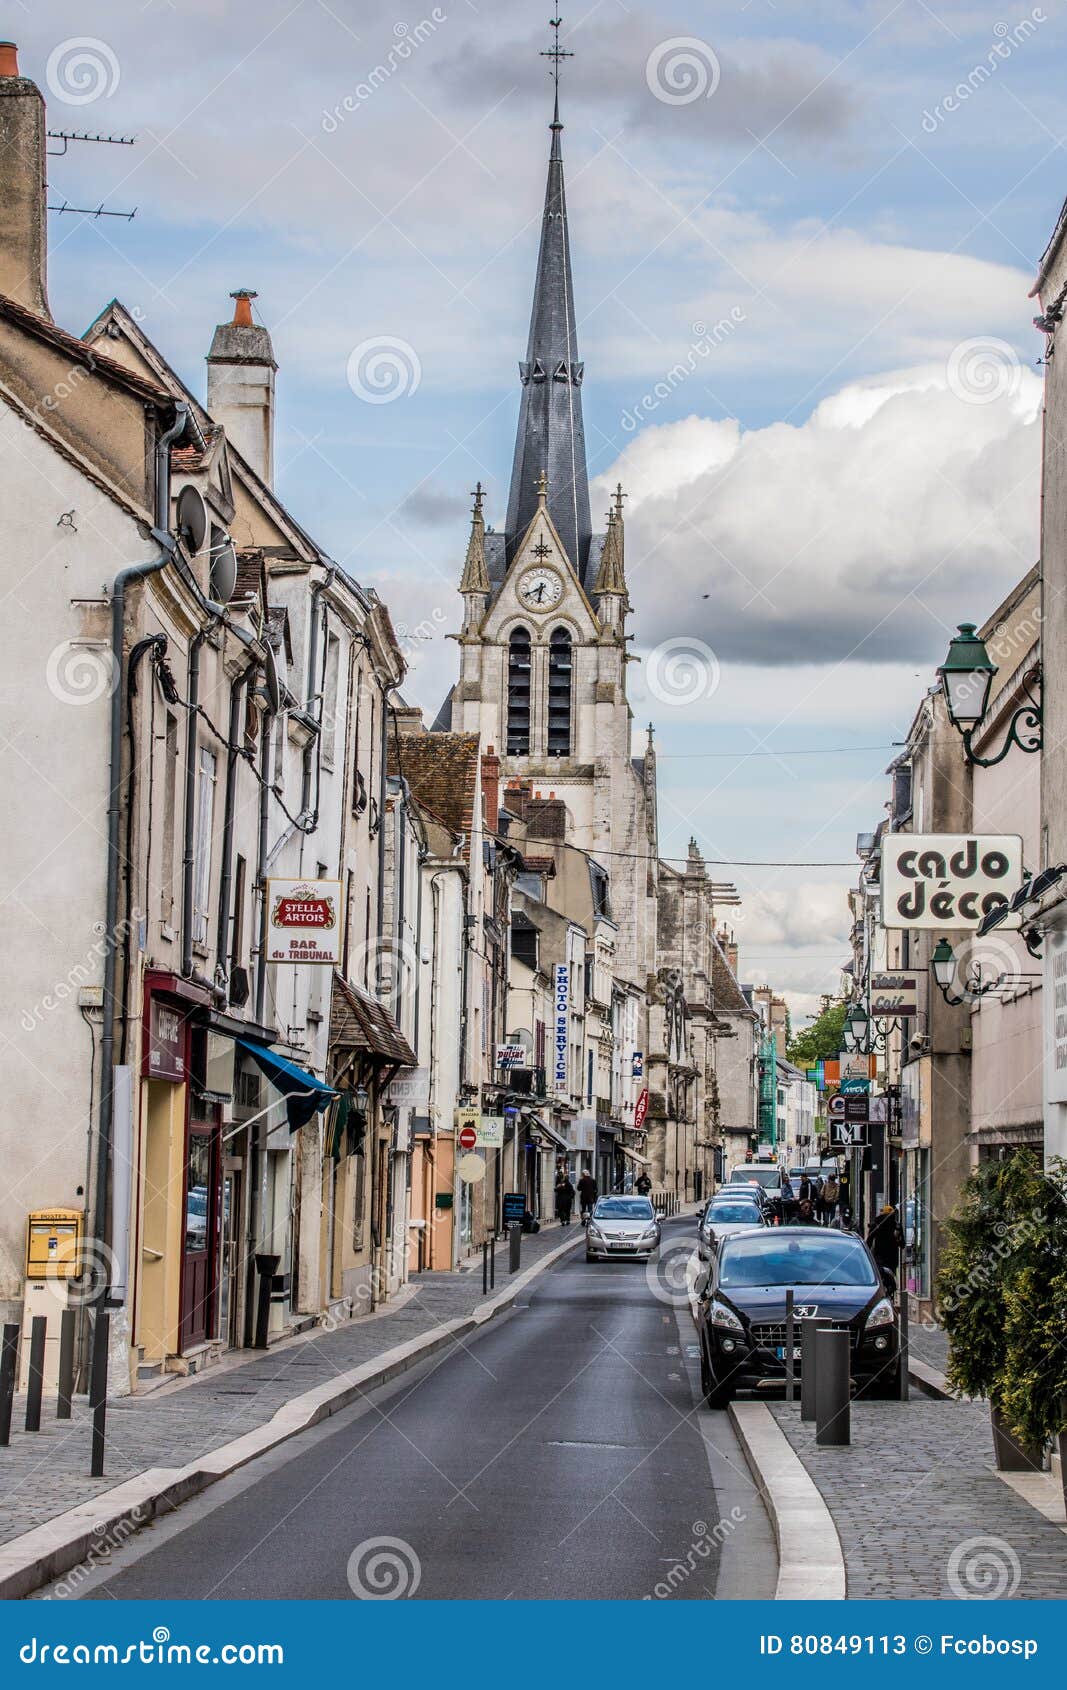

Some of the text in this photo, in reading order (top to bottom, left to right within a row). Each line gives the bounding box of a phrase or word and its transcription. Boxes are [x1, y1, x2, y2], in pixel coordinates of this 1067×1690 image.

[897, 840, 1010, 879] cado
[897, 881, 1009, 919] déco
[285, 904, 324, 913] STELLA
[285, 914, 325, 922] ARTOIS
[290, 940, 317, 949] BAR
[272, 950, 333, 960] du TRIBUNAL
[876, 996, 904, 1009] Coif
[556, 967, 568, 1080] PHOTO SERVICE
[497, 1050, 524, 1059] pulsat
[635, 1091, 648, 1126] TABAC
